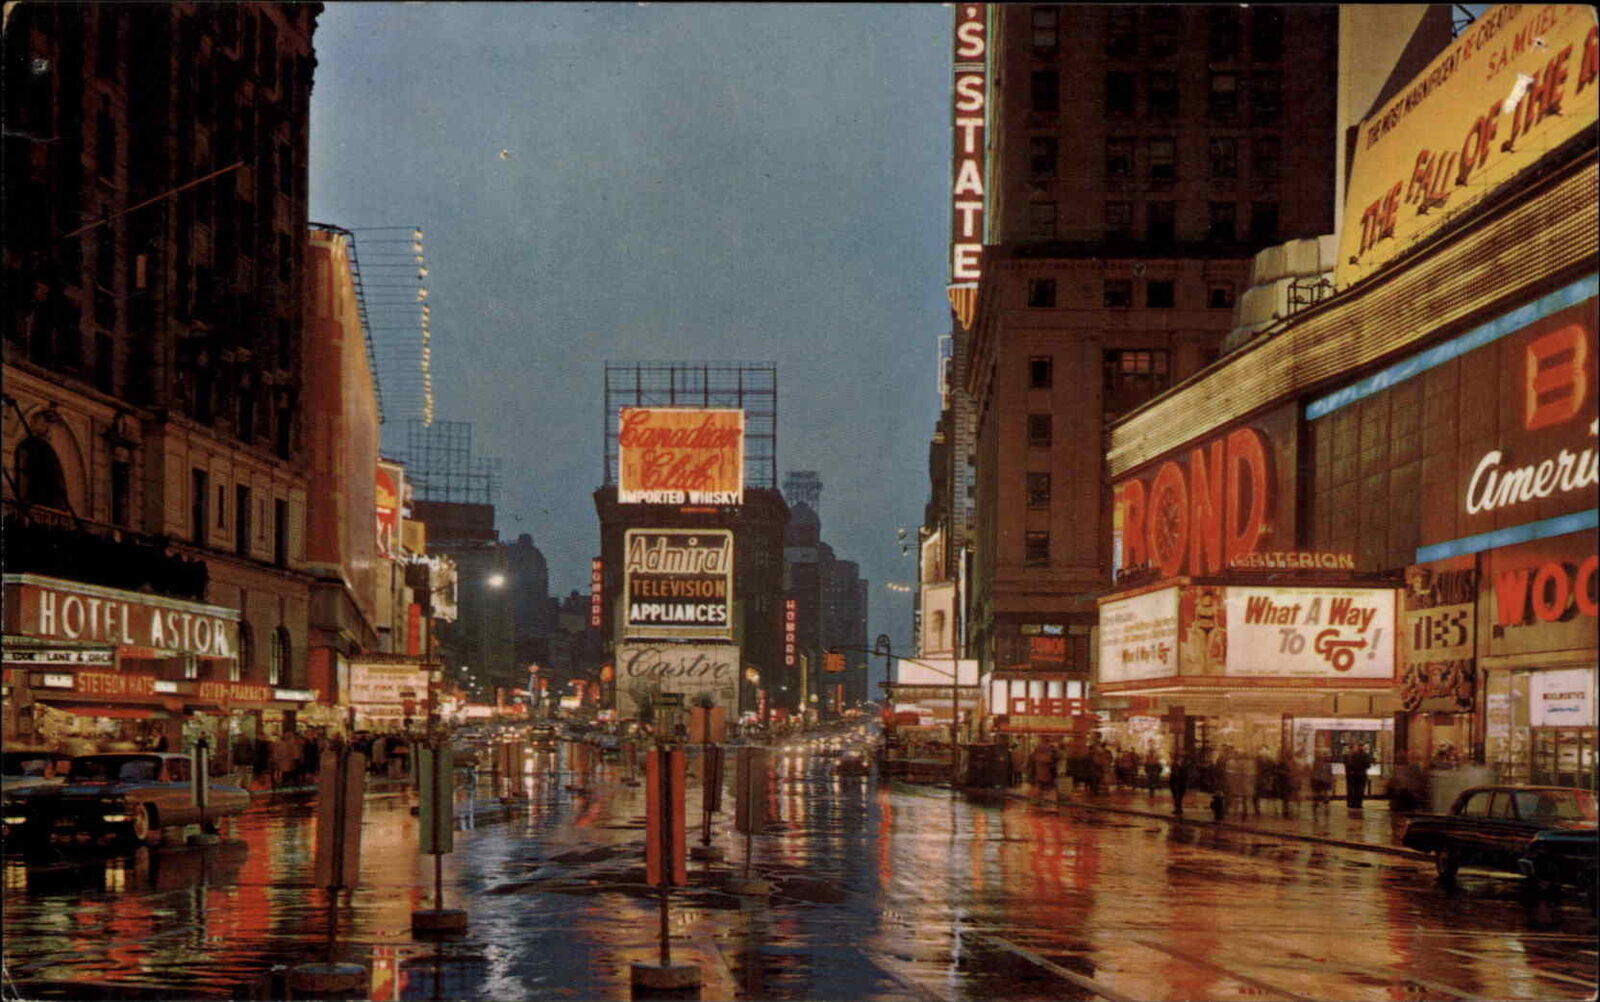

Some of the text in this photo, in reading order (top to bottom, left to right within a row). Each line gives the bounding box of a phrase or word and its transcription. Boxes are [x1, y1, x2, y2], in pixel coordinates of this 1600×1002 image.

[1359, 180, 1403, 257] THE
[1404, 149, 1458, 205] FALL
[1457, 99, 1504, 180] OF
[1506, 43, 1573, 146] THE
[953, 75, 985, 279] STATE
[617, 408, 742, 449] Canadian
[642, 449, 722, 490] Club
[622, 490, 738, 504] IMPORTED WHISKY
[1118, 428, 1268, 577] BOND
[627, 536, 731, 574] Admiral
[632, 579, 725, 597] TELEVISION
[39, 590, 230, 656] HOTEL ASTOR
[630, 603, 727, 622] APPLIANCES
[1244, 595, 1377, 634] What A Way
[623, 648, 732, 678] Castro
[78, 672, 155, 696] STETSON HATS
